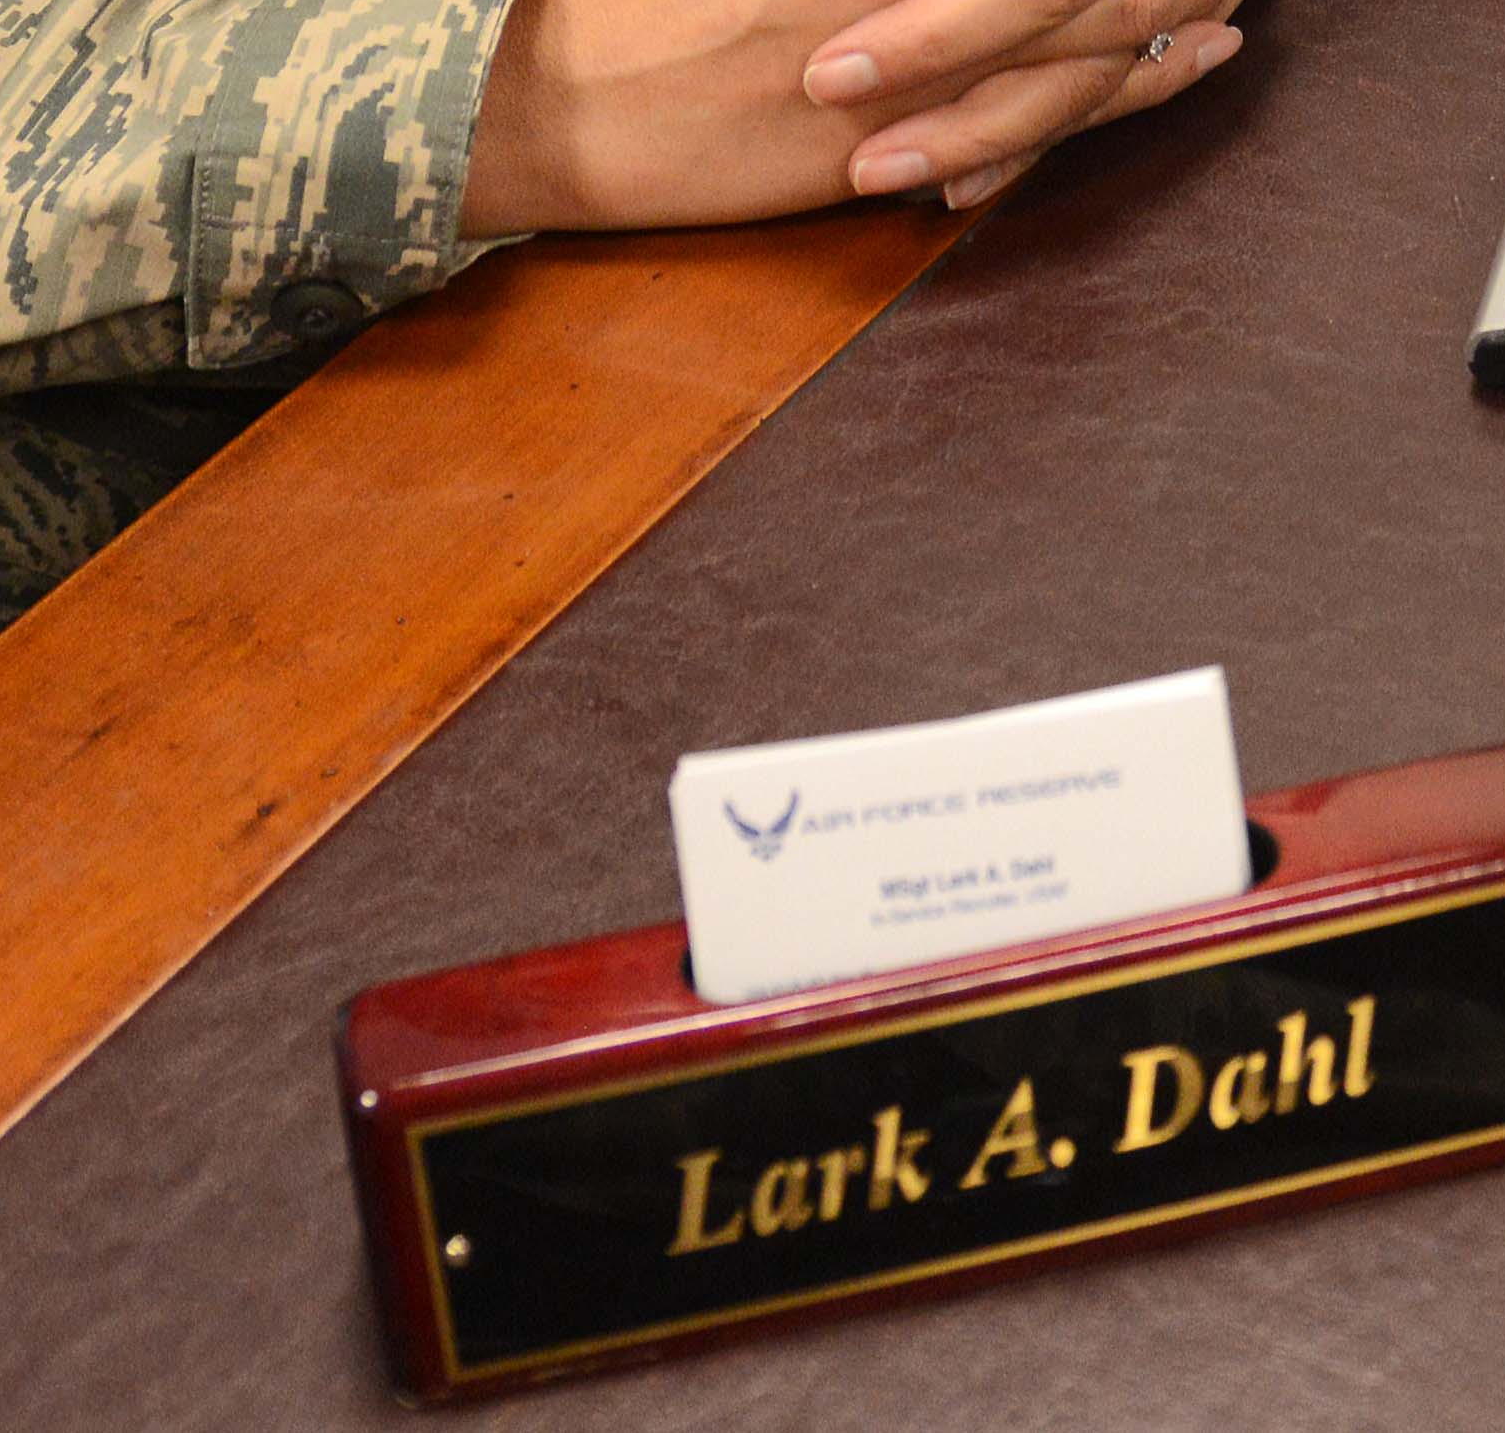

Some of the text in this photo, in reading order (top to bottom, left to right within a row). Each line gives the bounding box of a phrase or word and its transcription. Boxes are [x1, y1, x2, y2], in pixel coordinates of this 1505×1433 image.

[800, 769, 1122, 837] AIR FORCE RESERVE
[936, 866, 980, 893] Lark
[1010, 856, 1055, 879] Dahl
[667, 996, 1379, 1256] Lark A. Dahl
